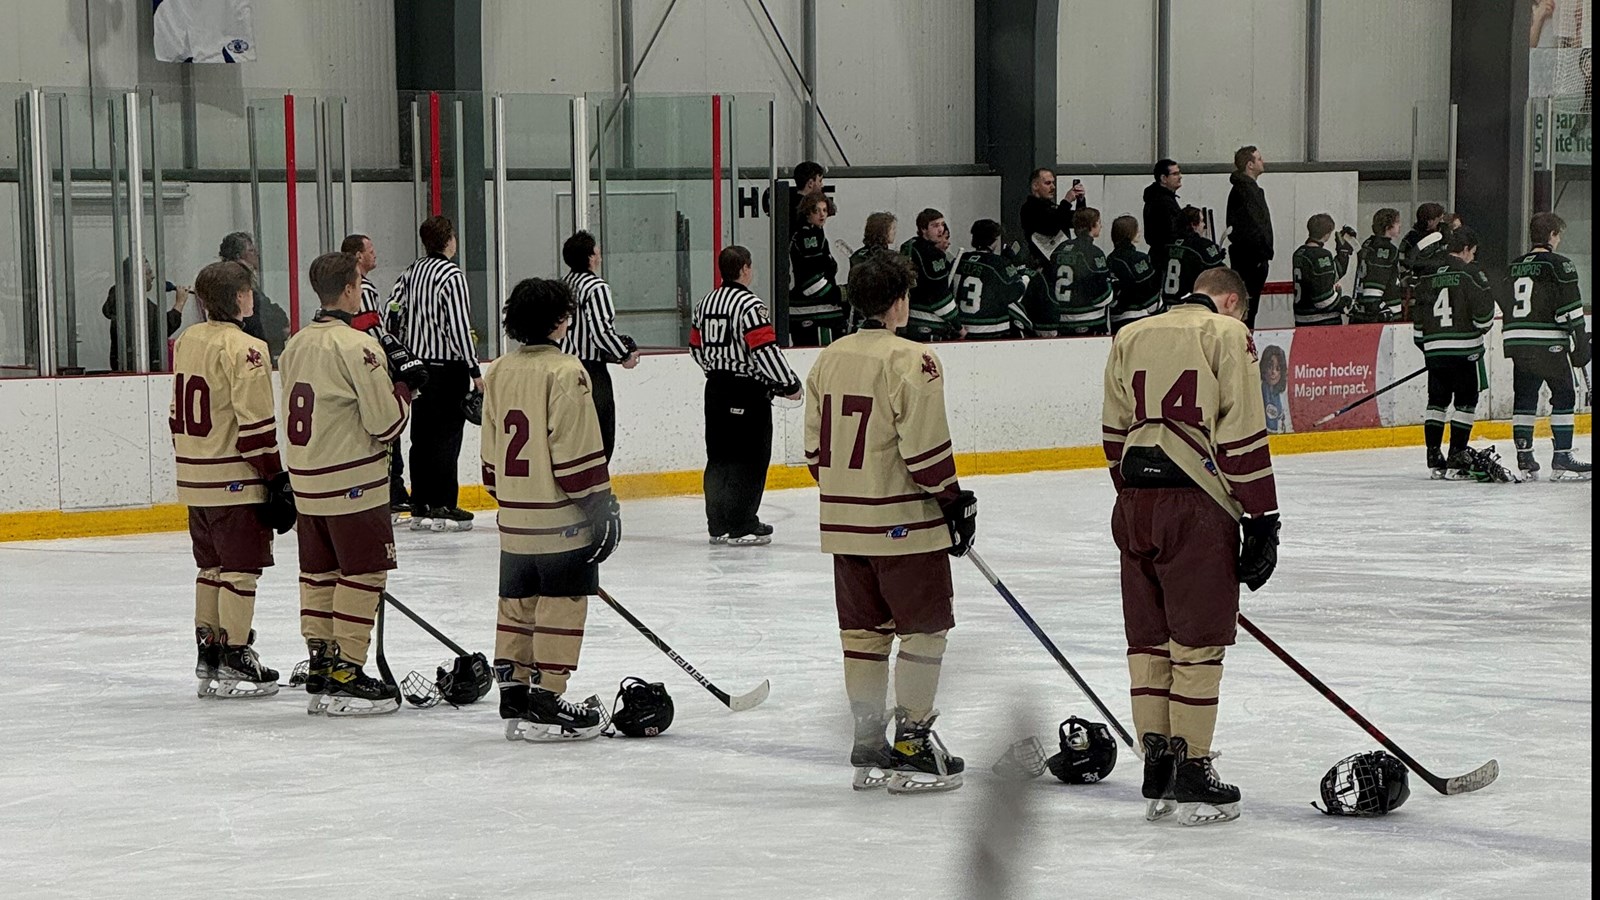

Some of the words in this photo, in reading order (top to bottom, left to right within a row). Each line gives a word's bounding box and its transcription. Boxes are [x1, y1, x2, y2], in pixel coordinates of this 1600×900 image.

[1055, 265, 1074, 302] 2
[1164, 258, 1182, 295] 8
[1511, 264, 1542, 277] CAMPOS
[1433, 287, 1453, 328] 4
[1512, 276, 1534, 318] 9
[704, 318, 727, 343] 107
[1294, 364, 1328, 379] Minor
[1330, 362, 1372, 379] hockey.
[169, 372, 213, 438] 10
[1131, 369, 1204, 431] 14
[1294, 382, 1328, 401] Major
[1329, 381, 1369, 399] impact.
[287, 381, 315, 447] 8
[818, 393, 874, 470] 17
[503, 409, 530, 478] 2
[667, 649, 711, 688] BAUER
